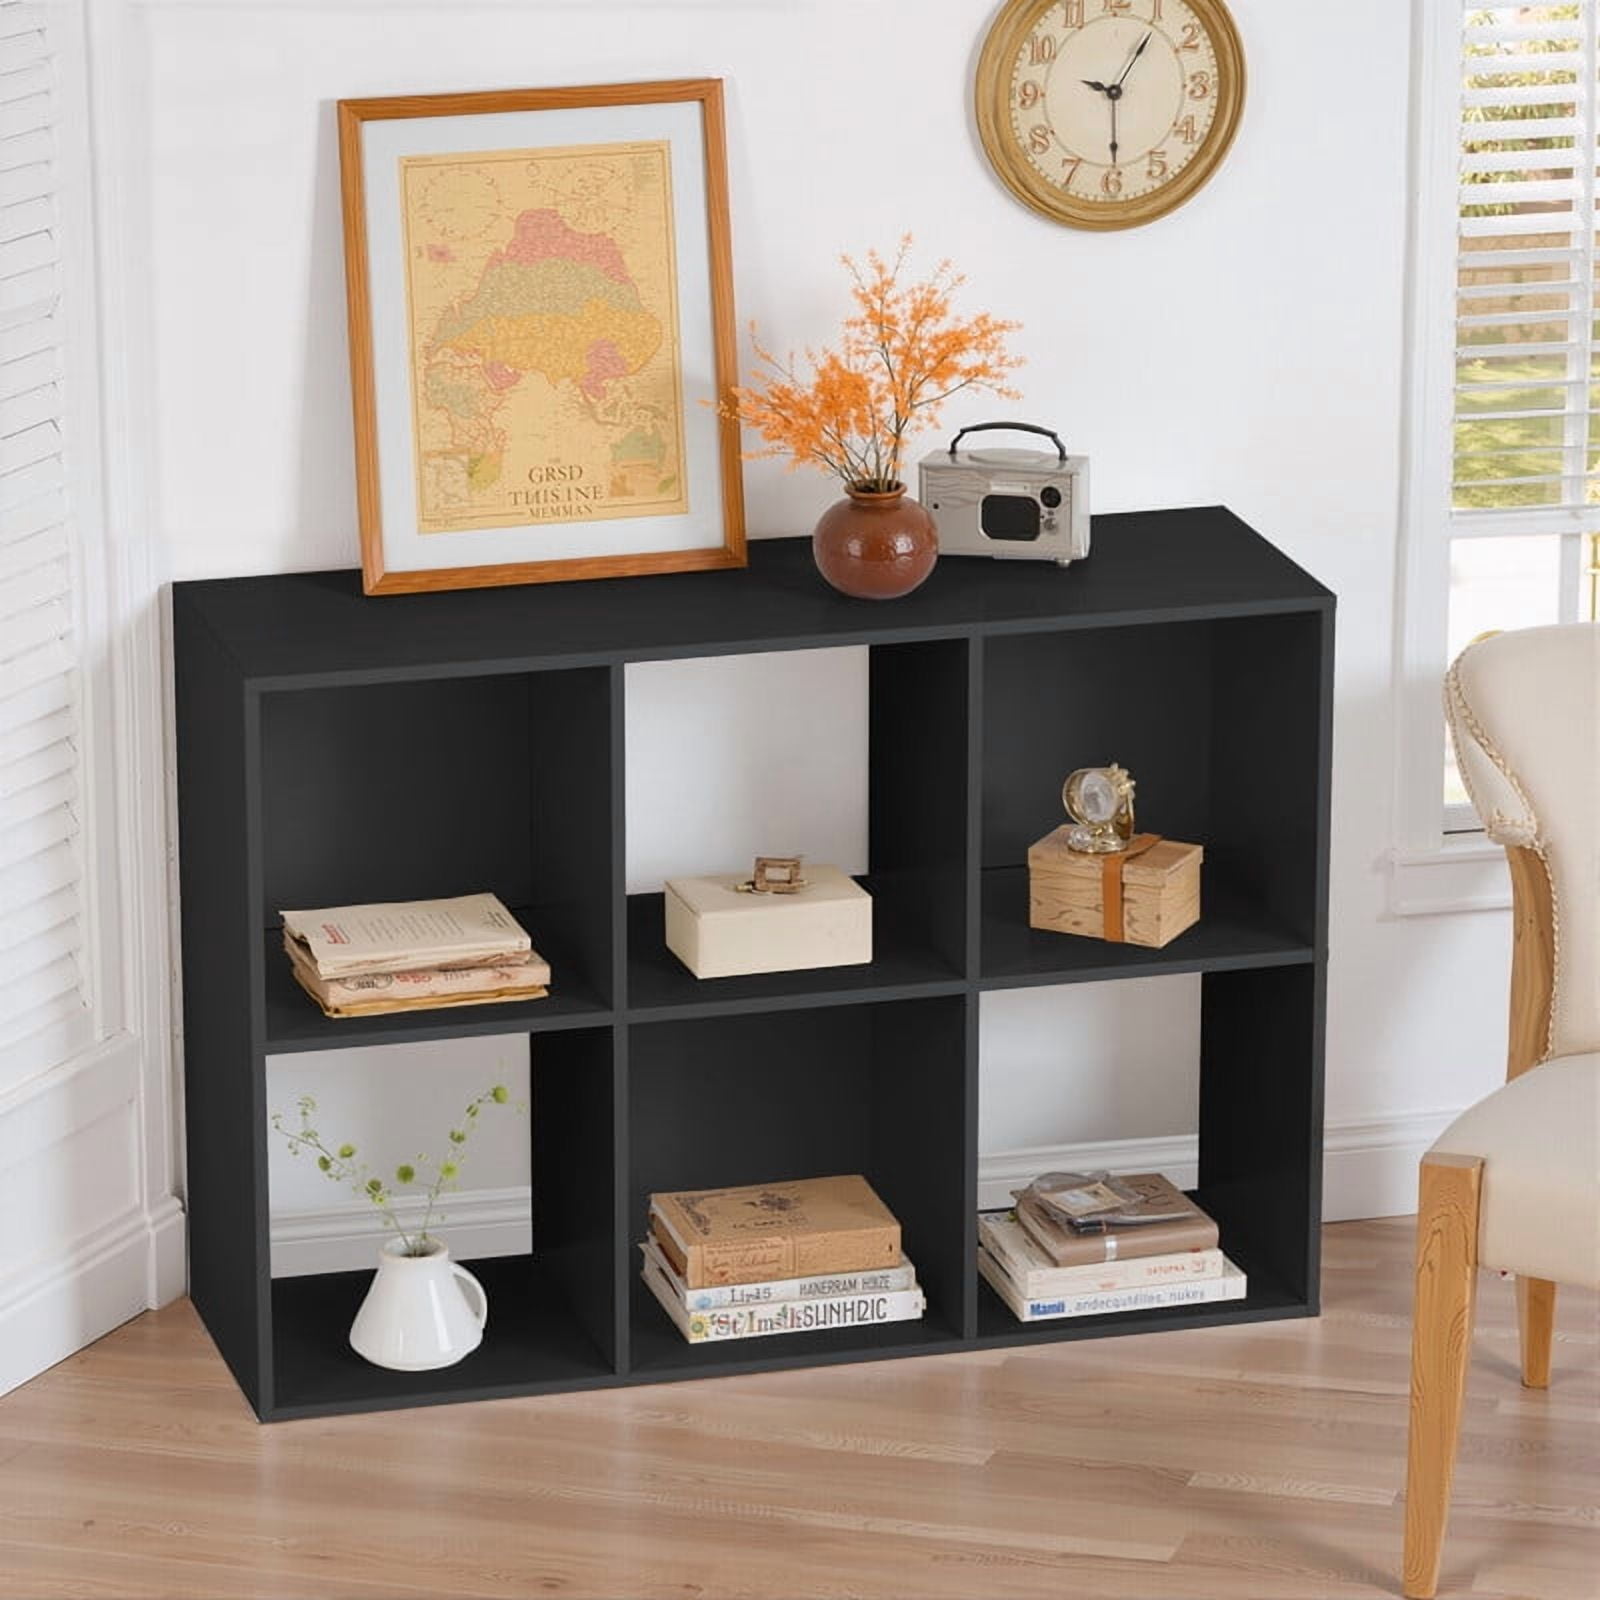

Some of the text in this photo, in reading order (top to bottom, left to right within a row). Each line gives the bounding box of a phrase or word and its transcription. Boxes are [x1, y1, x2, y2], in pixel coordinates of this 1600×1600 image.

[1029, 35, 1057, 65] 10
[1181, 23, 1200, 50] 2
[1017, 80, 1039, 110] 9
[1189, 71, 1209, 99] 3
[1028, 124, 1050, 154] 8
[1175, 115, 1197, 144] 4
[1061, 157, 1083, 188] 7
[1147, 151, 1168, 178] 5
[1101, 170, 1123, 194] 6
[527, 465, 584, 484] GRSD
